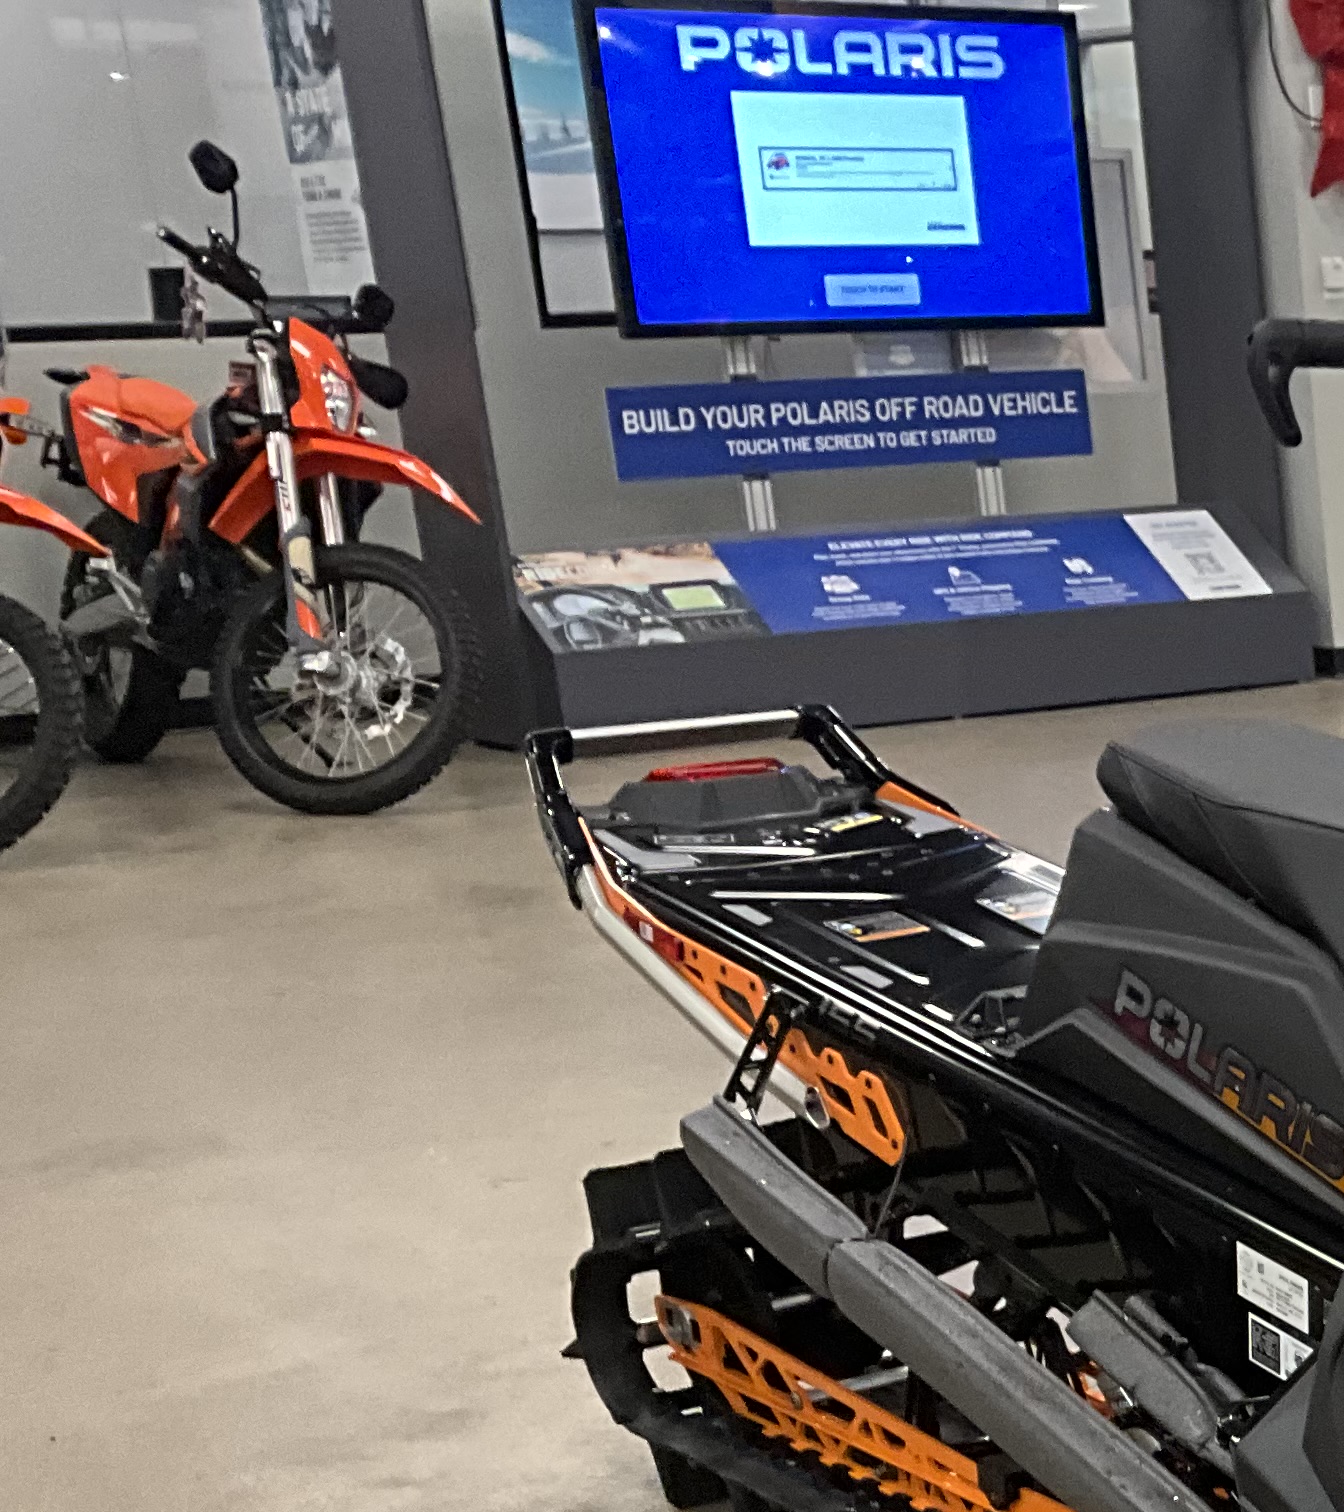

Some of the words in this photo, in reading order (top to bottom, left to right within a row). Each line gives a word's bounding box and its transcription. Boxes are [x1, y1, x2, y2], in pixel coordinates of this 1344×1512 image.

[675, 25, 1005, 80] POLARIS
[622, 407, 696, 435] BUILD
[701, 403, 766, 430] YOUR
[771, 399, 871, 427] POLARIS
[875, 396, 917, 422] OFF
[924, 394, 984, 420] ROAD
[987, 390, 1078, 416] VEHICLE
[725, 438, 780, 457] TOUCH
[783, 436, 813, 454] THE
[815, 432, 876, 453] SCREEN
[879, 432, 898, 449] TO
[900, 430, 929, 448] GET
[931, 427, 997, 446] STARTED
